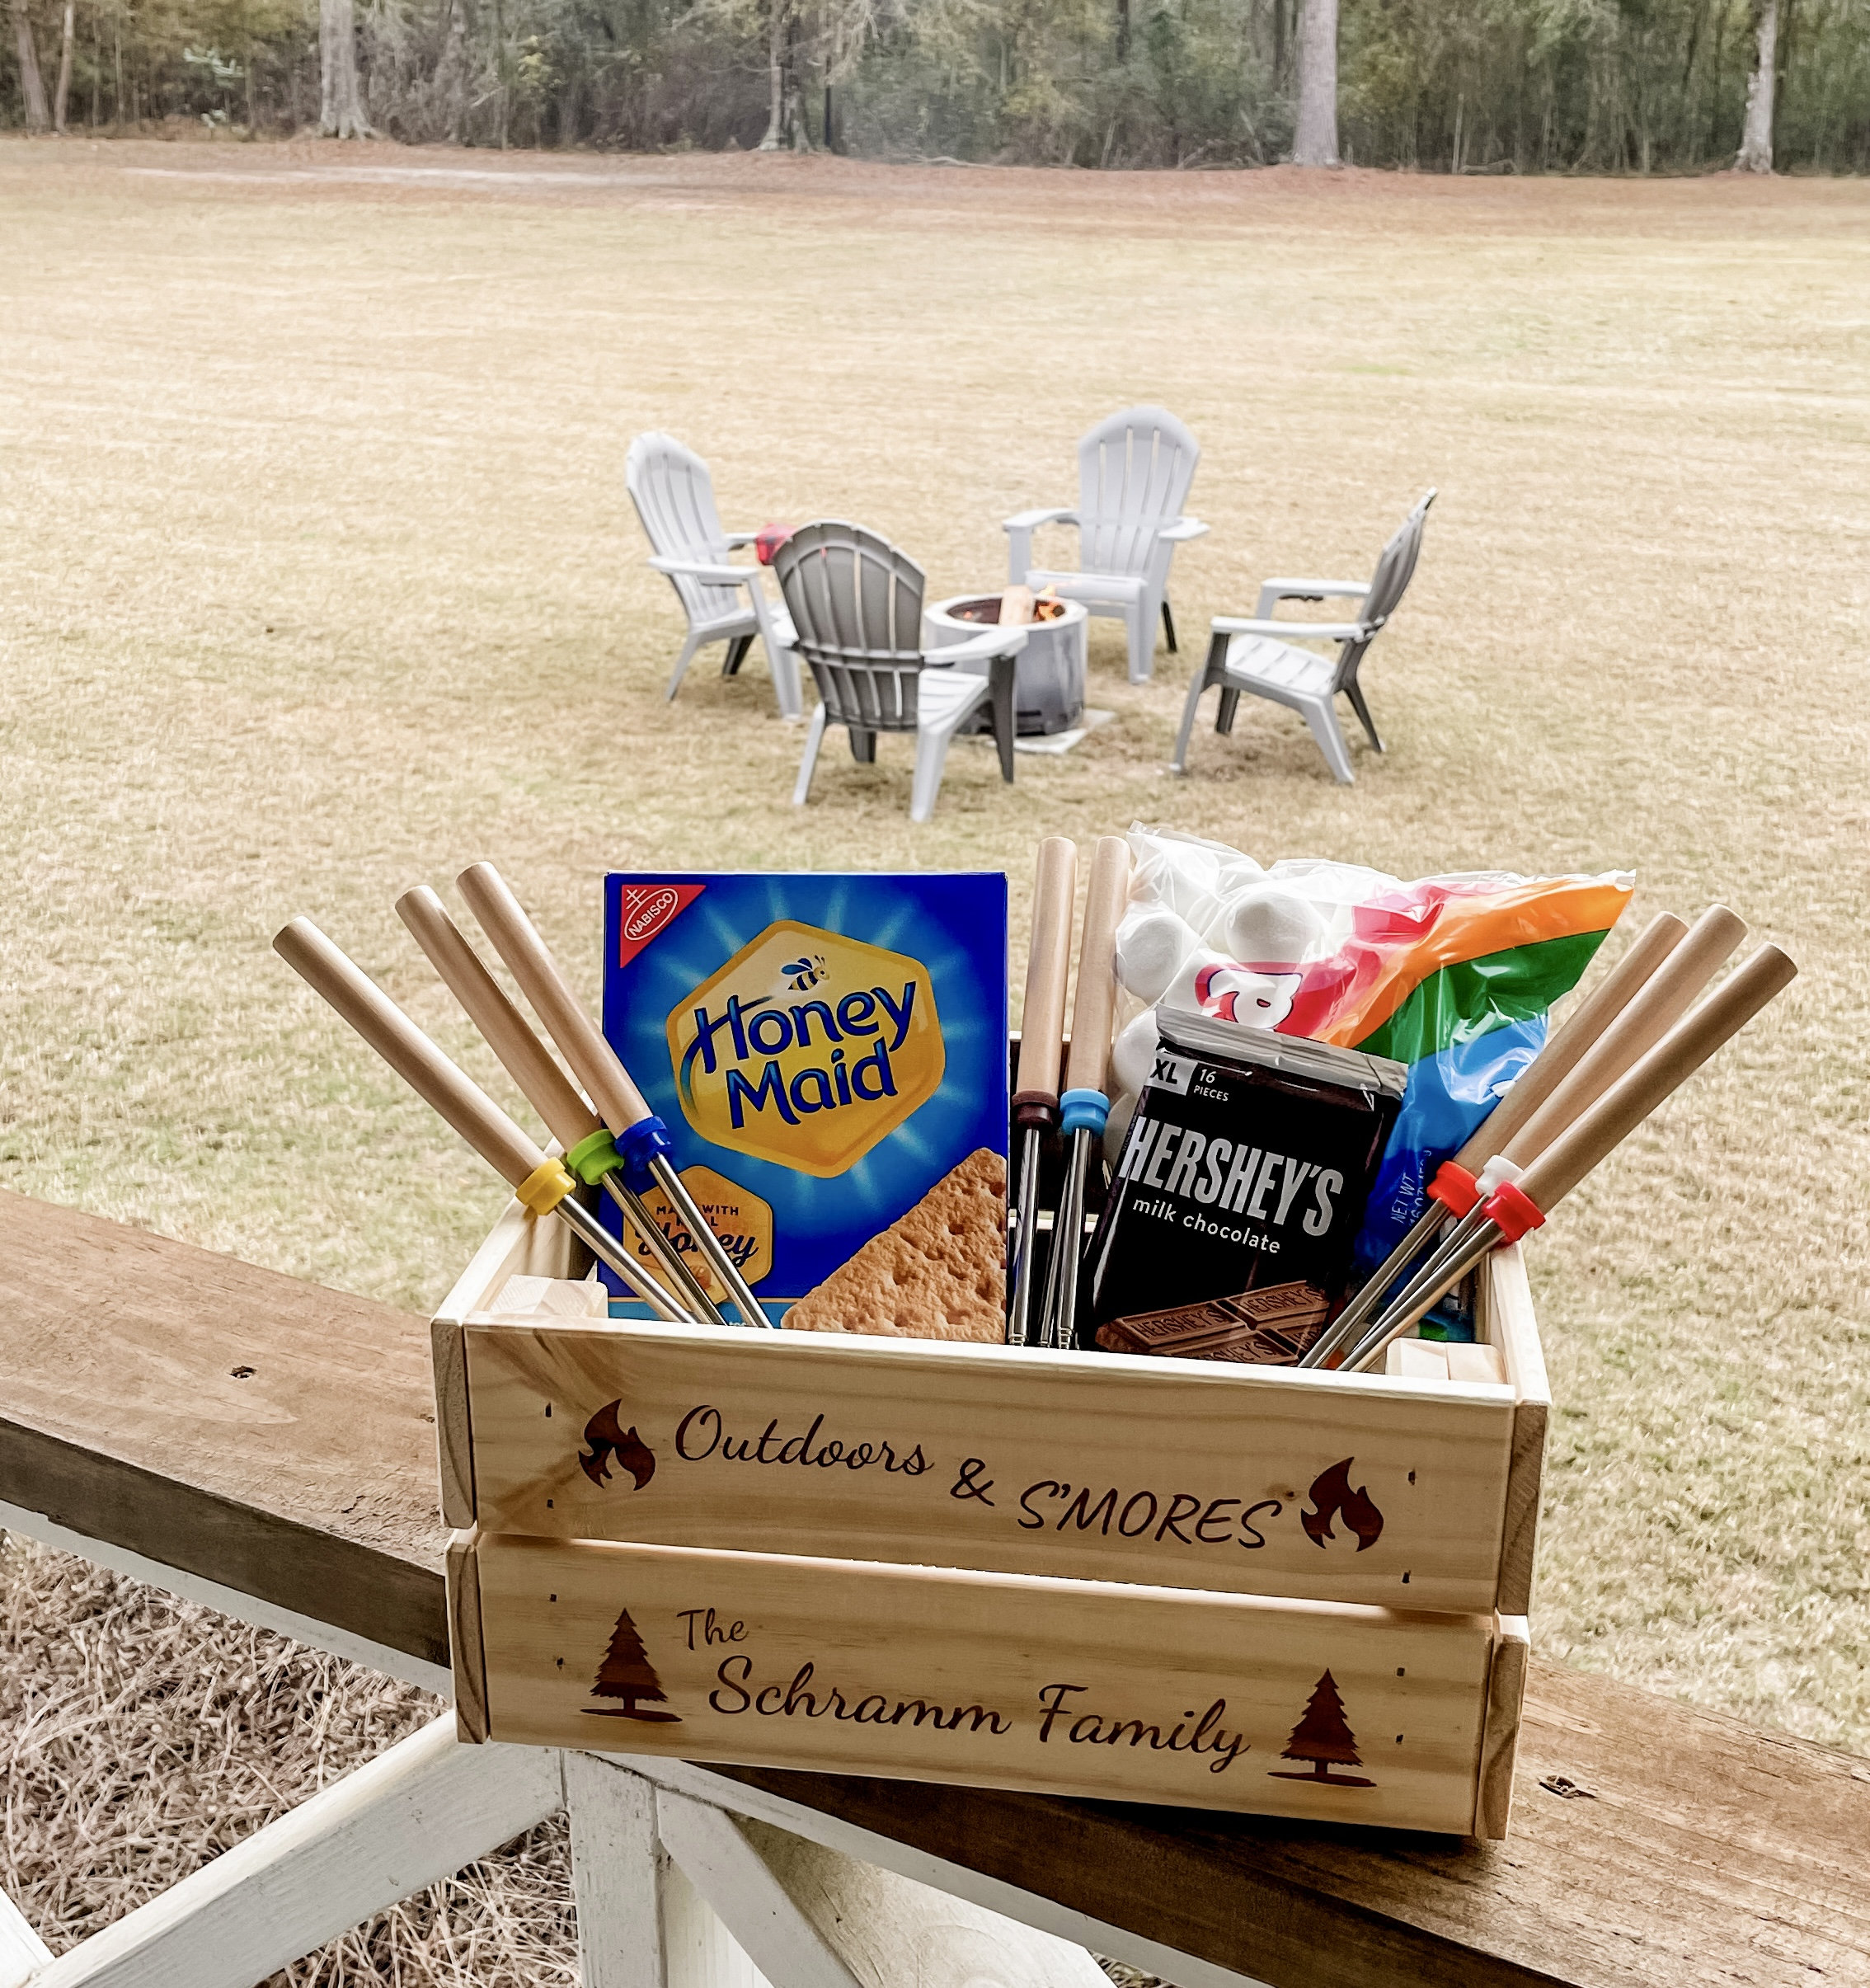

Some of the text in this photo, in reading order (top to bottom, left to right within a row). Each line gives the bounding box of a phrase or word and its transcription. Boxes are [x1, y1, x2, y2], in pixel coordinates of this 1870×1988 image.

[628, 892, 673, 937] NABISCO
[684, 981, 917, 1075] Honey
[726, 1036, 899, 1130] Maid
[1149, 1058, 1178, 1085] XL
[1193, 1084, 1229, 1102] PIECES
[1199, 1069, 1216, 1083] 16
[1118, 1116, 1344, 1237] HERSHEY'S
[1390, 1172, 1416, 1224] NET WT
[702, 1204, 740, 1216] WITH
[1132, 1199, 1280, 1254] milk chocolate
[1130, 1309, 1224, 1339] HERSHEY'S
[675, 1405, 1281, 1549] Outdoors & S'MORES
[676, 1608, 749, 1650] The
[709, 1656, 1251, 1773] Schramm Family
